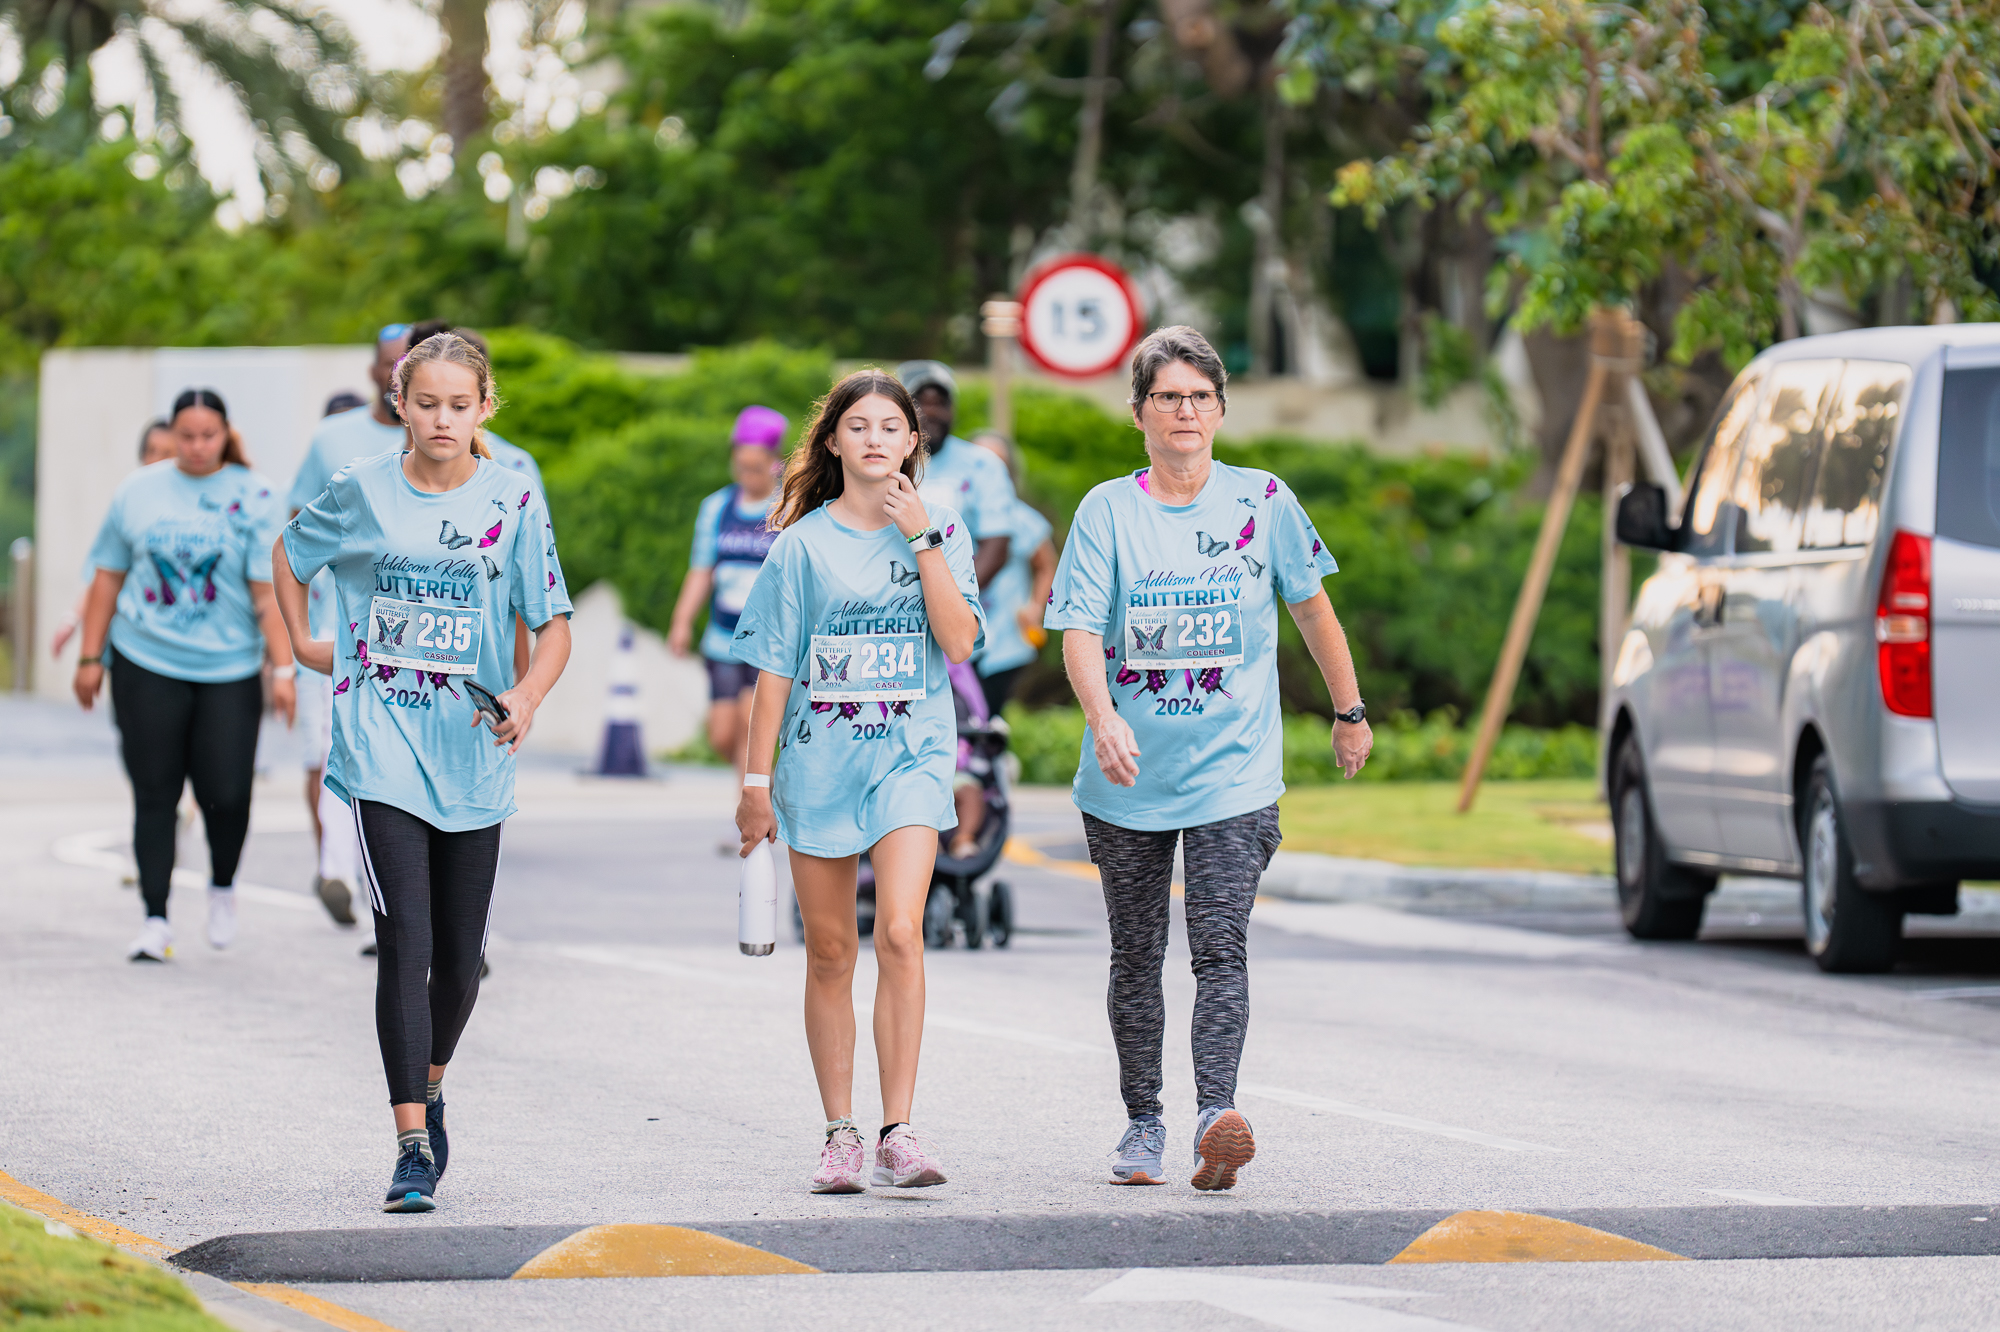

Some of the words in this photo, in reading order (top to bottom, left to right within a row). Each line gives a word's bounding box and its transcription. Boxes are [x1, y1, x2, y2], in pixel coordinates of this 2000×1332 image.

[1051, 298, 1106, 342] 15
[373, 553, 430, 574] Addison
[434, 559, 479, 584] Kelly
[1129, 569, 1197, 592] Addison
[1200, 564, 1243, 590] Kelly
[1130, 587, 1241, 607] BUTTERFLY
[376, 607, 410, 619] BUTTERFLY
[826, 600, 887, 622] Addison
[1130, 617, 1168, 625] BUTTERFLY
[416, 611, 472, 652] 235
[828, 617, 926, 636] BUTTERFLY
[1177, 610, 1233, 647] 232
[424, 651, 460, 662] CASSIDY
[860, 641, 917, 679] 234
[1186, 648, 1225, 657] COLLEEN
[875, 681, 903, 689] CASEY
[383, 687, 432, 711] 2024
[1154, 697, 1205, 716] 2024
